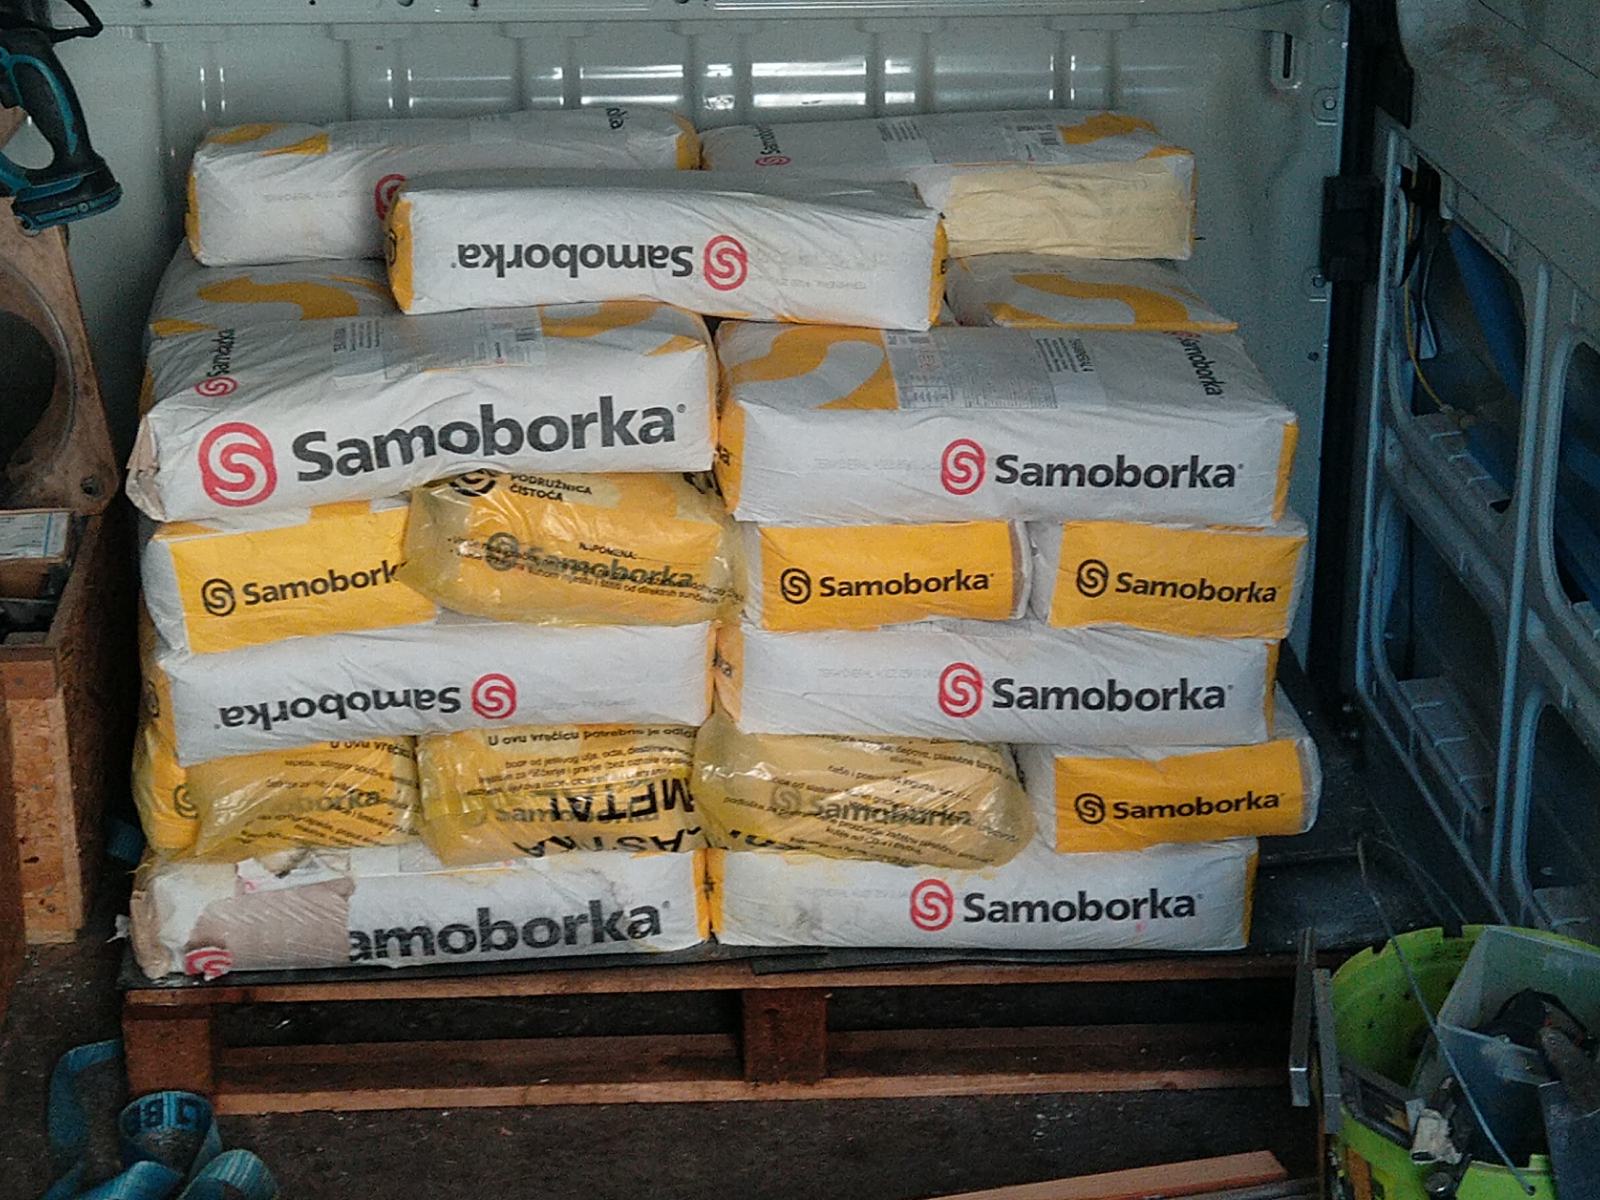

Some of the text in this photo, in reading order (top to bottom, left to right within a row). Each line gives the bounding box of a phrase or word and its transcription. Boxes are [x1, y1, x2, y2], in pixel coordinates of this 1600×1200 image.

[457, 243, 693, 279] Samoborka
[292, 395, 675, 482] Samoborka
[994, 454, 1236, 489] Samoborka
[243, 560, 399, 605] Samobork
[819, 569, 989, 597] Samoborka
[1115, 572, 1279, 604] Samoborka
[219, 686, 463, 731] Samoborka
[991, 677, 1226, 713] Samoborka
[1112, 790, 1281, 820] Samoborka
[963, 887, 1198, 924] Samoborka
[348, 899, 663, 963] amoborka
